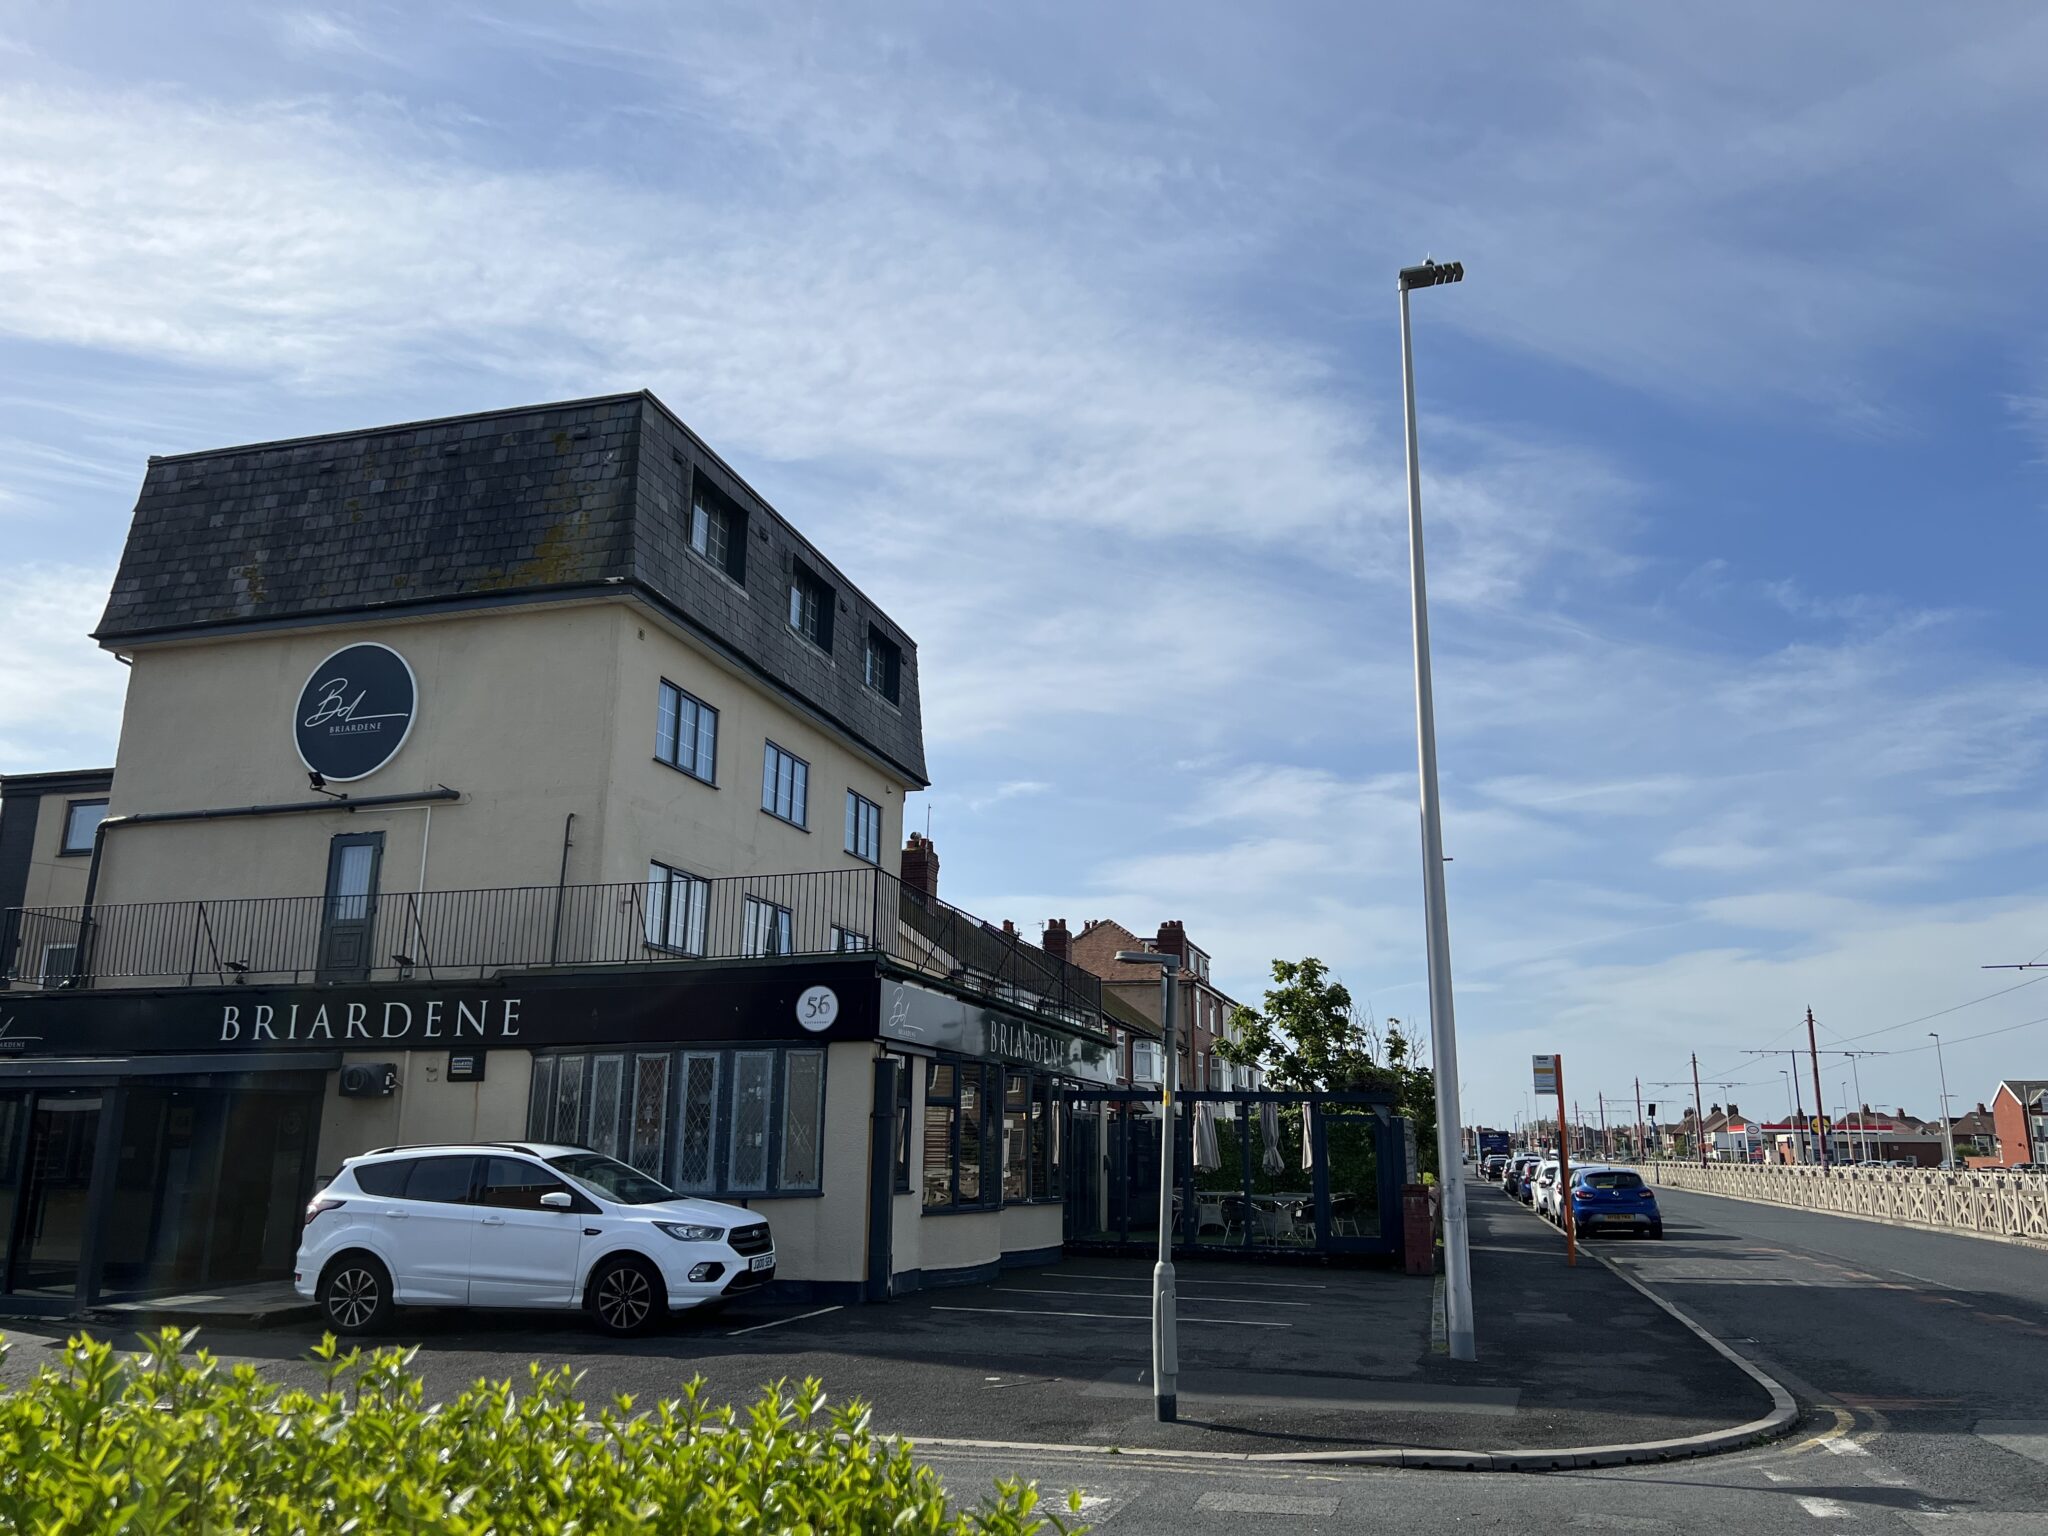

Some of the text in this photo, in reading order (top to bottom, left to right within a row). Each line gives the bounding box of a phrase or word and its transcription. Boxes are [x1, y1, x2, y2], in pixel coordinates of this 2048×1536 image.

[329, 722, 382, 734] BRIARDENE
[220, 999, 521, 1041] BRIARDENE
[804, 994, 830, 1018] 56
[990, 1020, 1065, 1068] BRIARDENE
